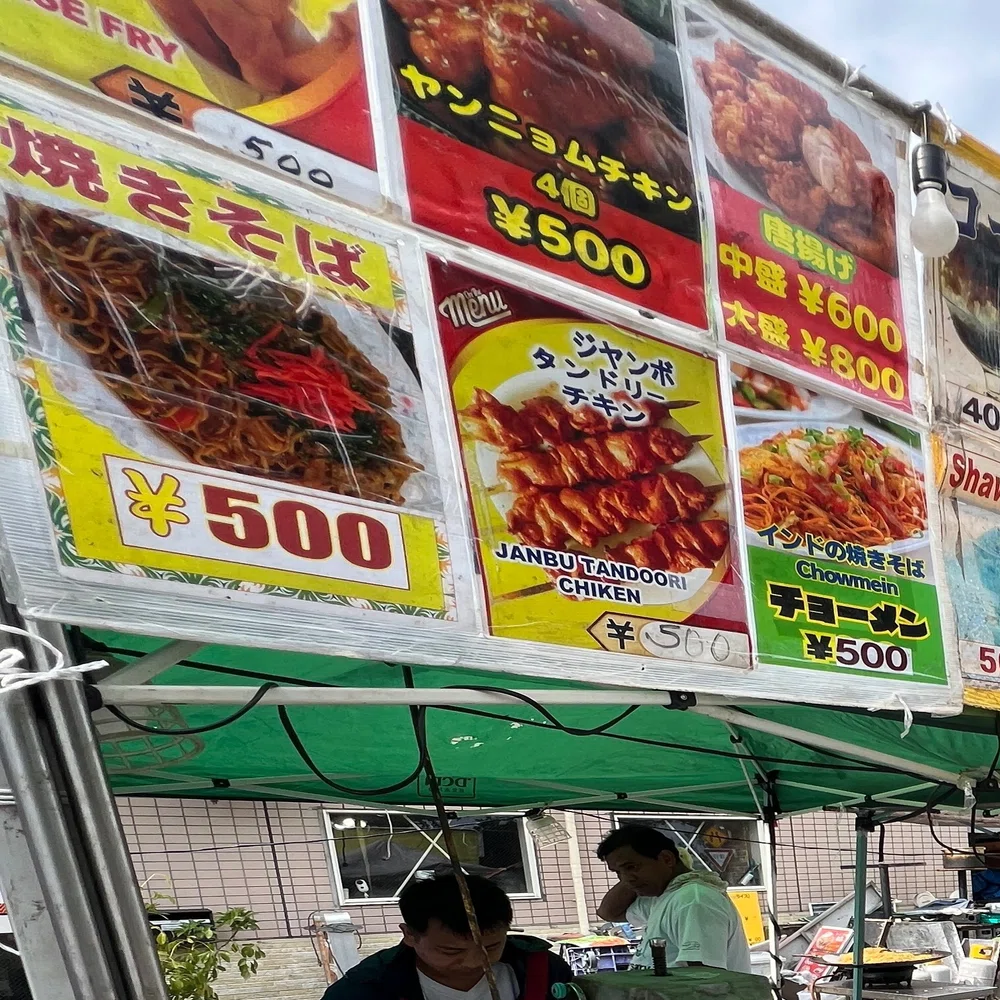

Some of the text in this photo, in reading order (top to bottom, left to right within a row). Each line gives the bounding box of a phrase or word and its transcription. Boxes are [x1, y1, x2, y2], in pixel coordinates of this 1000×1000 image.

[98, 10, 179, 65] FRY
[126, 75, 334, 189] ¥ 500
[400, 64, 692, 211] ヤンニョムチキン
[0, 115, 371, 292] 焼きそば
[536, 172, 597, 218] 4個
[490, 193, 647, 285] ¥500
[763, 212, 854, 281] 唐揚げ
[439, 289, 512, 328] Menu
[719, 242, 903, 353] 中盛 ¥600
[532, 346, 665, 400] タンドリー
[722, 300, 905, 401] 大盛 ¥800
[562, 384, 645, 422] チキン
[121, 467, 392, 570] ¥ 500
[495, 543, 688, 591] JANBU TANDOORI
[759, 525, 926, 579] インドの焼きそば
[797, 560, 899, 596] Chowmein
[559, 576, 641, 605] CHIKEN
[768, 582, 930, 639] チョーメン
[645, 623, 731, 663] 500
[805, 631, 908, 672] ¥500
